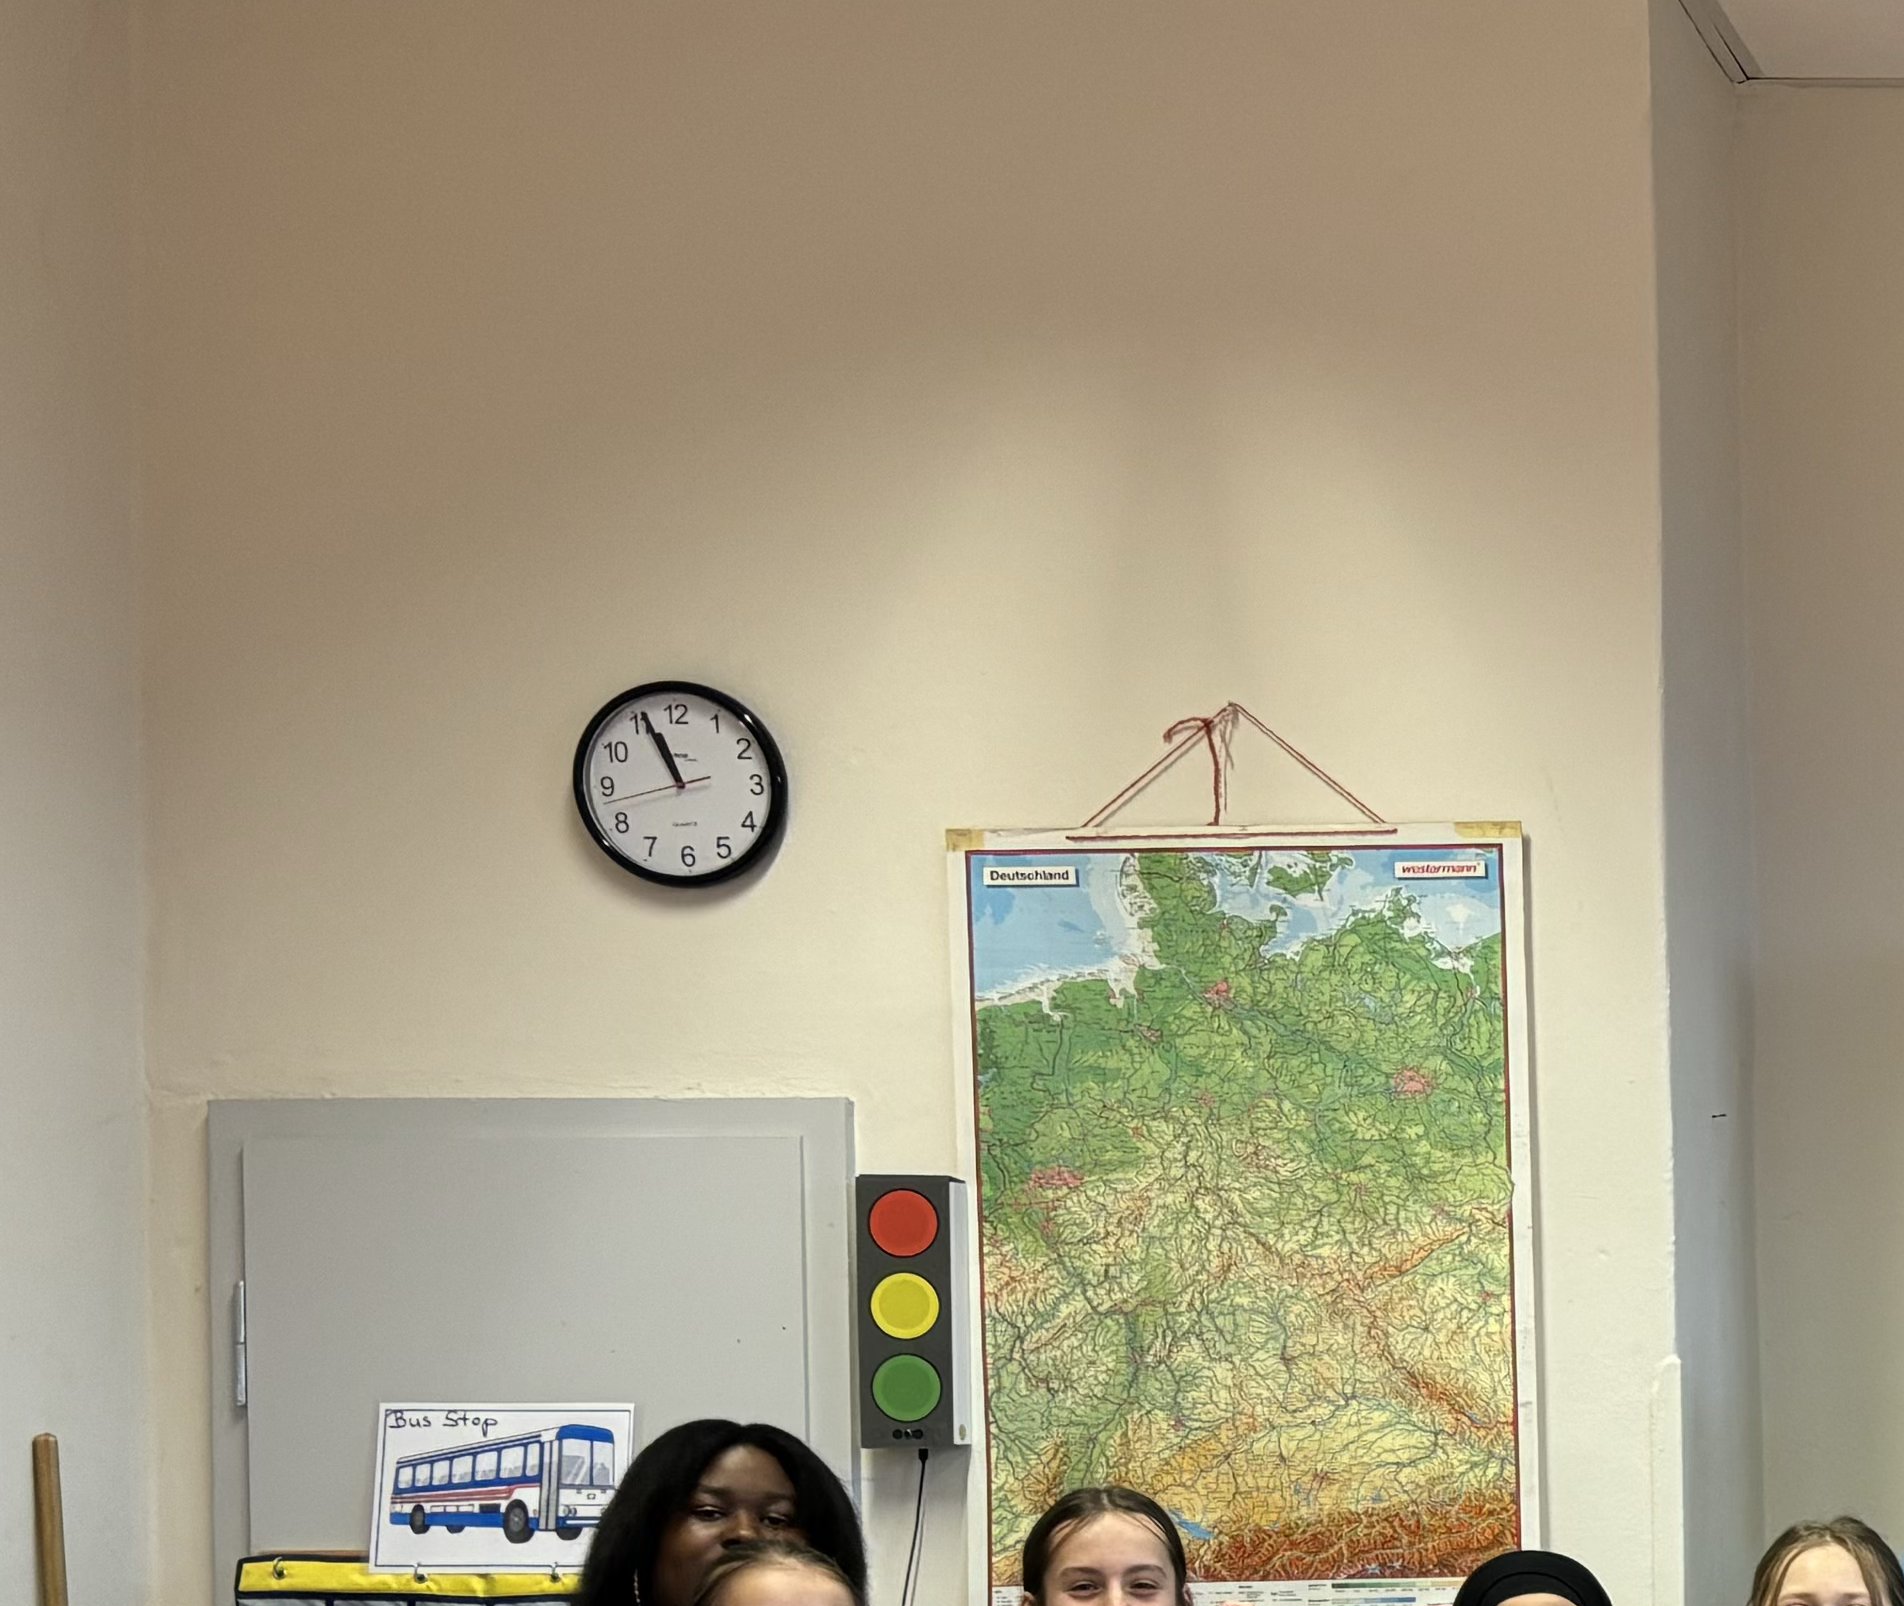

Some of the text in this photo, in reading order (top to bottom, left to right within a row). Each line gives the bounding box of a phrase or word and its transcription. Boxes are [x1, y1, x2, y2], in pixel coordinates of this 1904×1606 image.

[663, 704, 689, 725] 12
[710, 714, 720, 734] 1
[603, 741, 629, 763] 10
[736, 738, 753, 760] 2
[600, 776, 615, 797] 9
[749, 774, 765, 796] 3
[614, 812, 630, 834] 8
[741, 811, 757, 833] 4
[643, 836, 658, 858] 7
[680, 845, 696, 868] 6
[716, 836, 732, 859] 5
[989, 870, 1070, 881] Deutschland
[386, 1410, 498, 1438] Bus Stop
